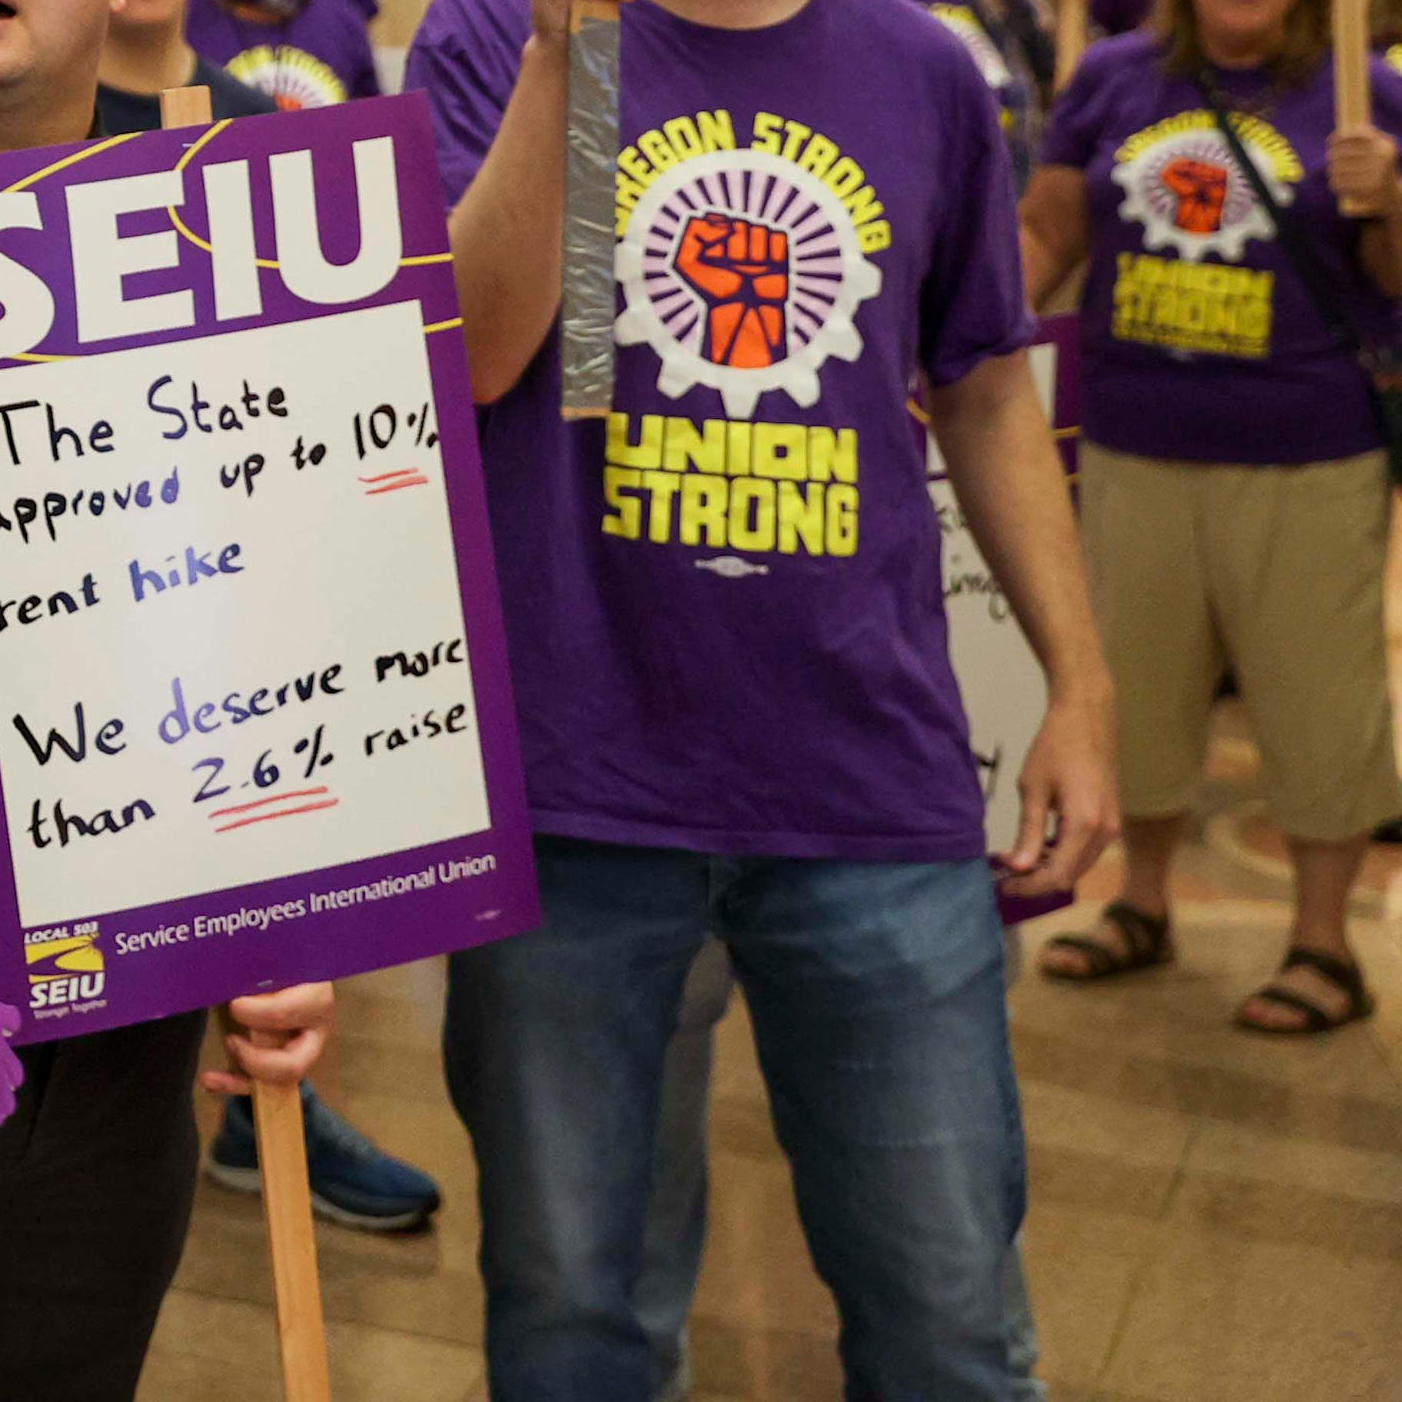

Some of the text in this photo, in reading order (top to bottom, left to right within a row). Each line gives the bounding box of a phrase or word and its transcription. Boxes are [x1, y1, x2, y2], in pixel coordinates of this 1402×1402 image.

[751, 111, 893, 254] STRONG
[146, 374, 291, 443] State
[219, 451, 266, 501] up
[290, 436, 328, 474] to
[353, 401, 441, 464] 10%
[604, 412, 859, 485] UNION
[601, 465, 859, 558] STRONG
[128, 536, 247, 605] hike
[11, 634, 466, 768] We deserve more
[26, 698, 471, 851] than 2.6% raise
[24, 926, 70, 944] LOCAL
[115, 852, 497, 956] Service Employees International Union
[29, 972, 105, 1009] SEIU
